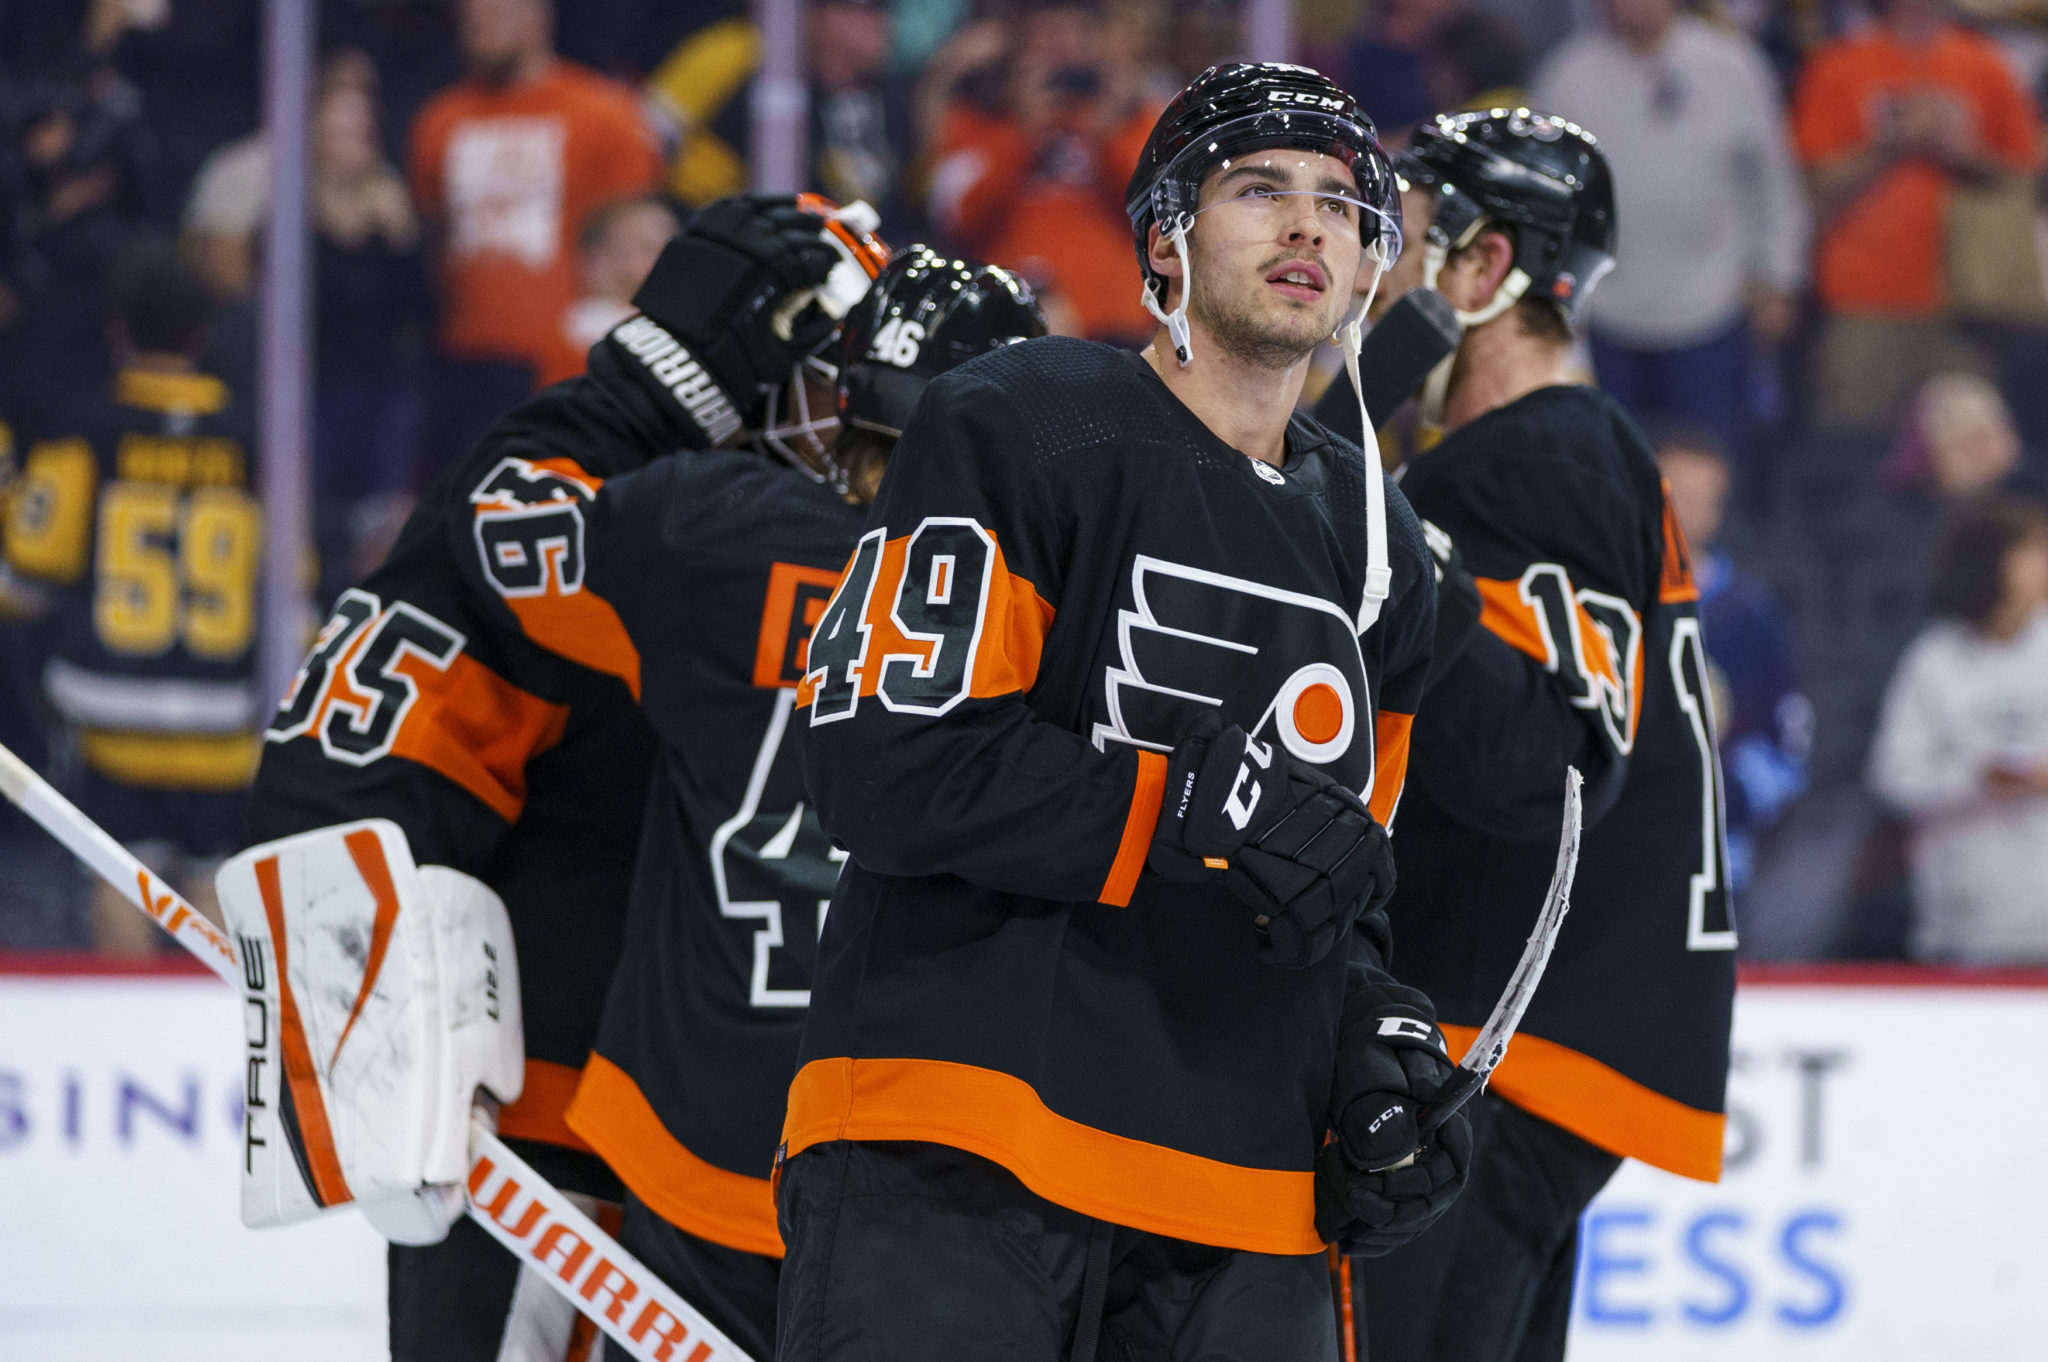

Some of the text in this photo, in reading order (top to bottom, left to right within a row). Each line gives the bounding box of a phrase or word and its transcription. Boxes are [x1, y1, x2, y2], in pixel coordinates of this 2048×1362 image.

[1267, 90, 1345, 111] CCM
[613, 315, 743, 445] WARRIOR
[871, 316, 926, 368] 46
[96, 482, 264, 658] 59
[806, 516, 997, 728] 49
[1176, 770, 1196, 820] FLYERS
[1221, 732, 1274, 832] CC
[1668, 617, 1740, 951] 1
[708, 687, 850, 1008] 4
[237, 932, 268, 1176] TRUE
[1368, 1104, 1404, 1134] CCM
[467, 1154, 715, 1362] WARRI
[1578, 1207, 1848, 1328] ESS
